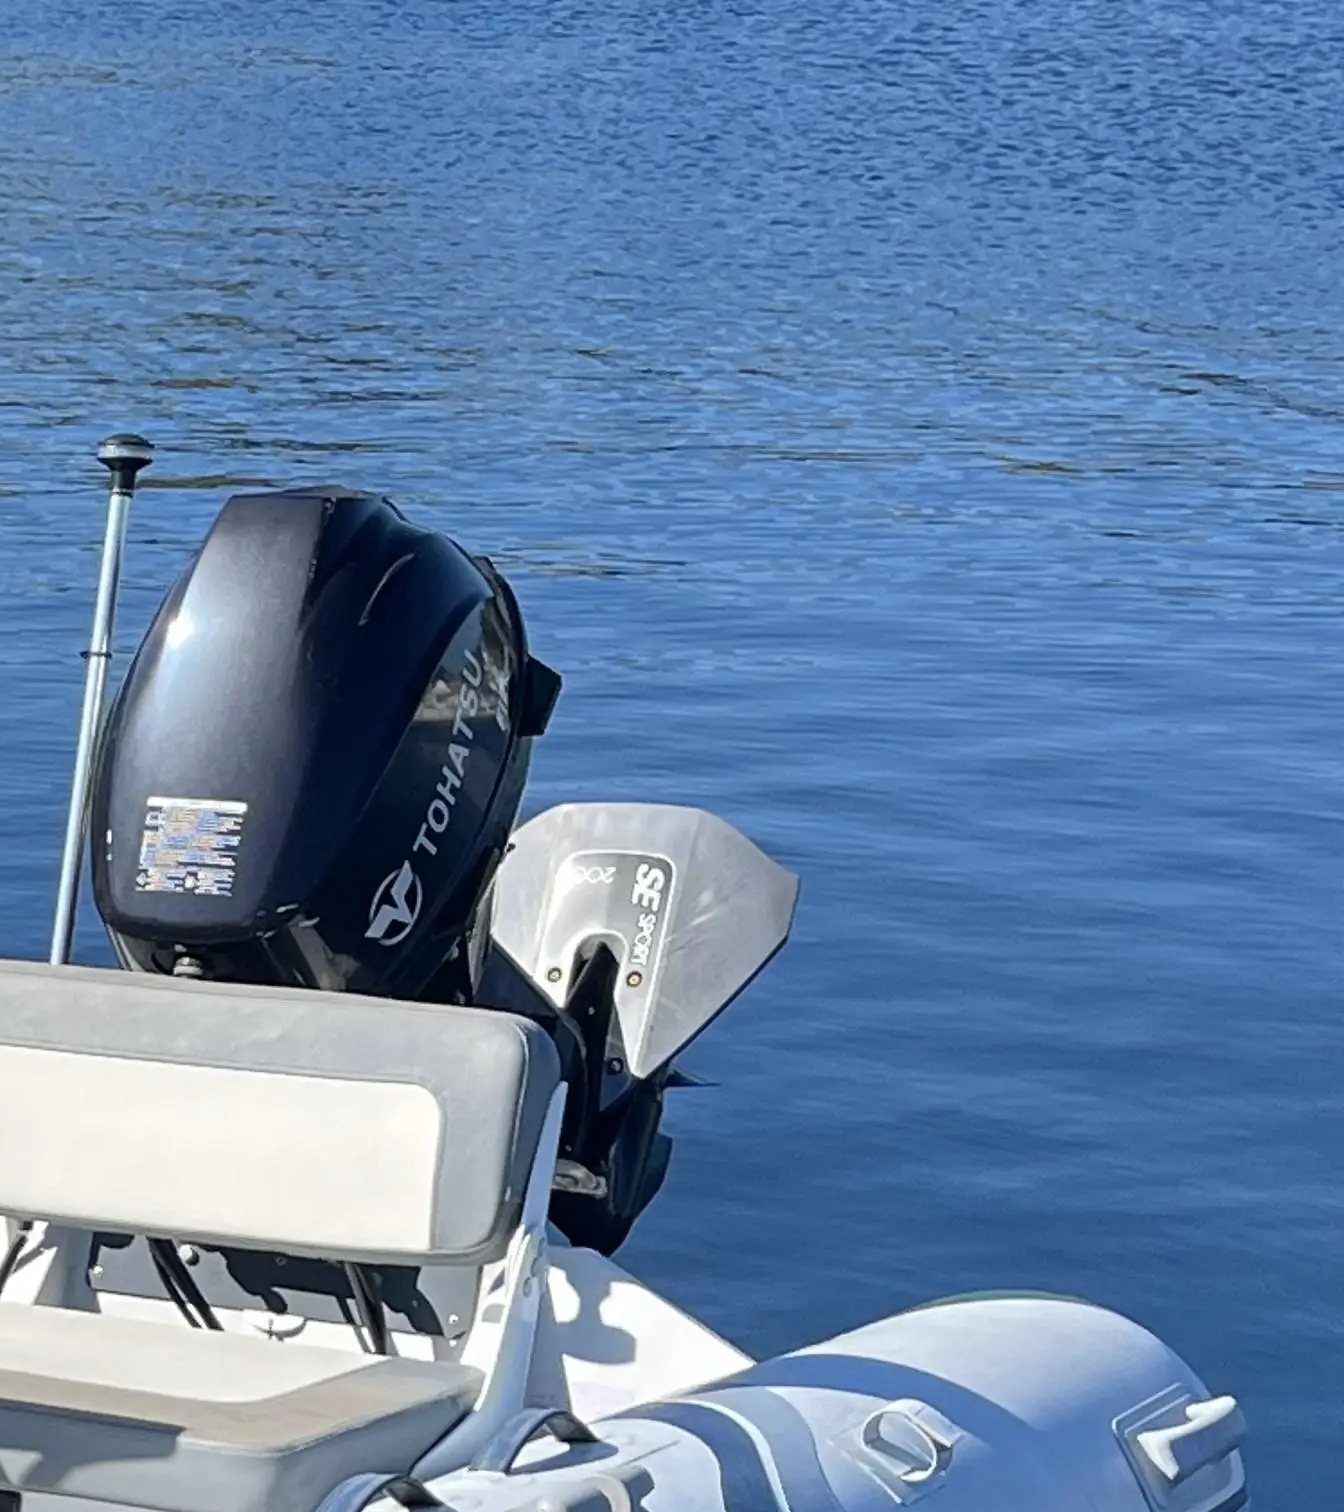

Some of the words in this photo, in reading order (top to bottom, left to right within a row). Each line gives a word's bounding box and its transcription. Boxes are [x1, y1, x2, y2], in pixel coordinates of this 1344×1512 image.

[413, 649, 483, 856] TOHATSU
[631, 863, 666, 911] SE
[631, 913, 657, 966] SPORT
